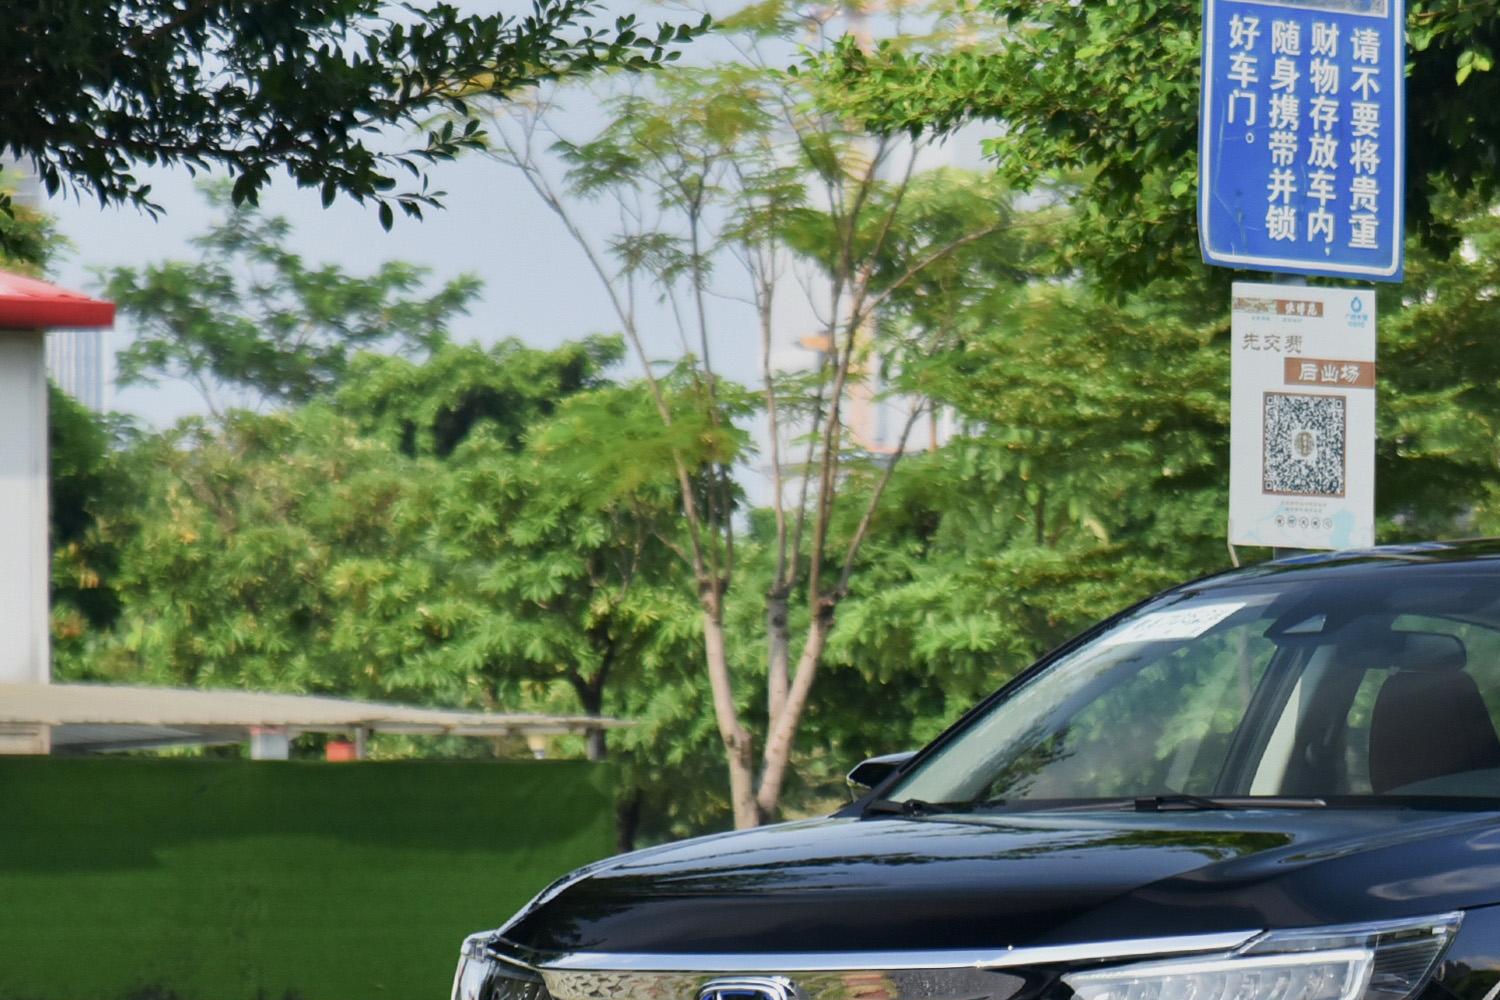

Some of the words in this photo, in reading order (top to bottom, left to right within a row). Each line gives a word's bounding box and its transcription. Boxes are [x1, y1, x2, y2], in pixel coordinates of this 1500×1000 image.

[1227, 14, 1260, 144] 好车门。
[1265, 20, 1300, 242] 随身携带并锁
[1348, 28, 1380, 250] 请不要将贵重
[1242, 332, 1303, 354] 先交费
